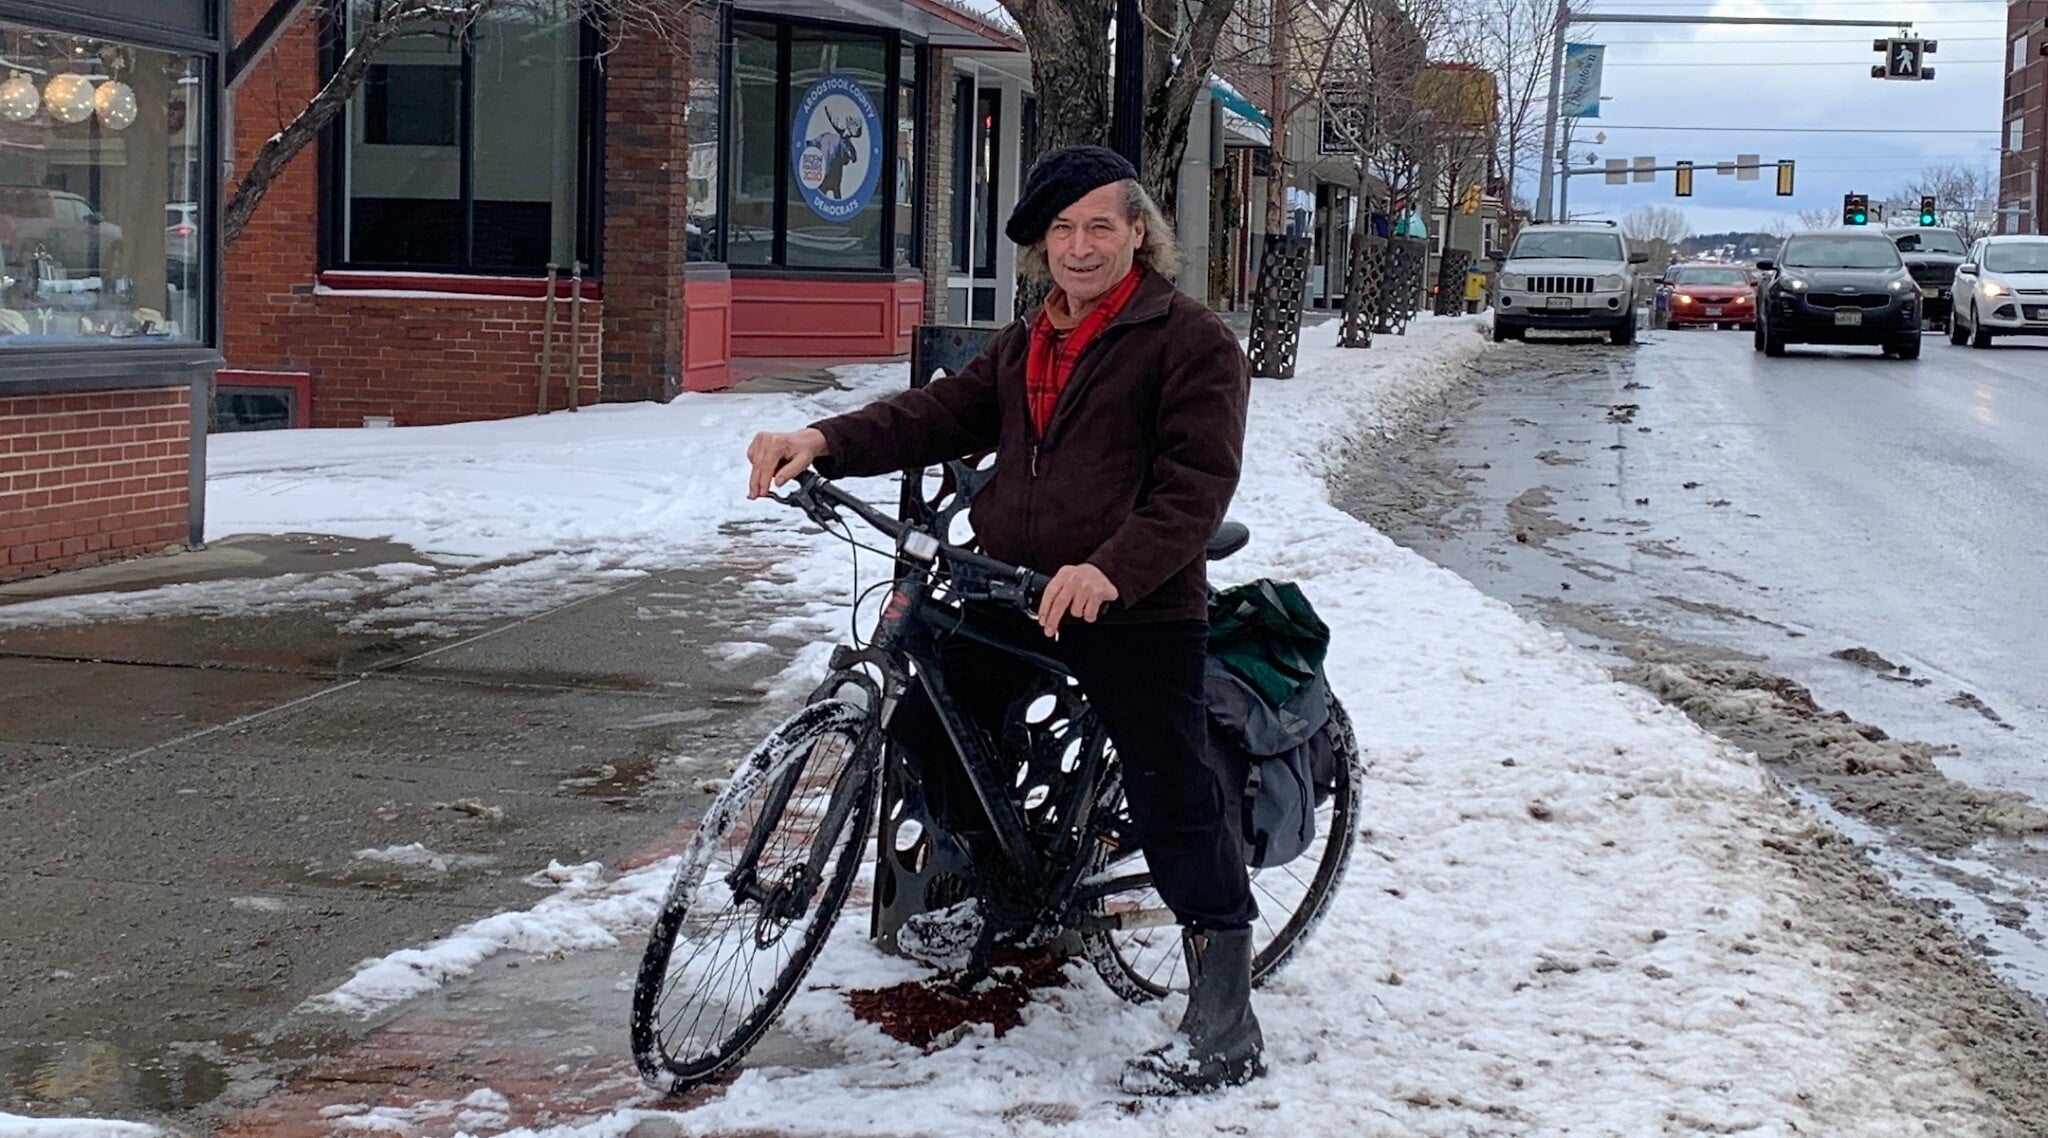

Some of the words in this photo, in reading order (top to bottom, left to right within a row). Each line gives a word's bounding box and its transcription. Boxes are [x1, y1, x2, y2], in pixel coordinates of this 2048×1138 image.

[803, 79, 848, 114] AROOSTOOK
[849, 83, 874, 118] COUNTY
[1562, 54, 1596, 106] Downtown
[814, 196, 859, 216] DEMOCRATS
